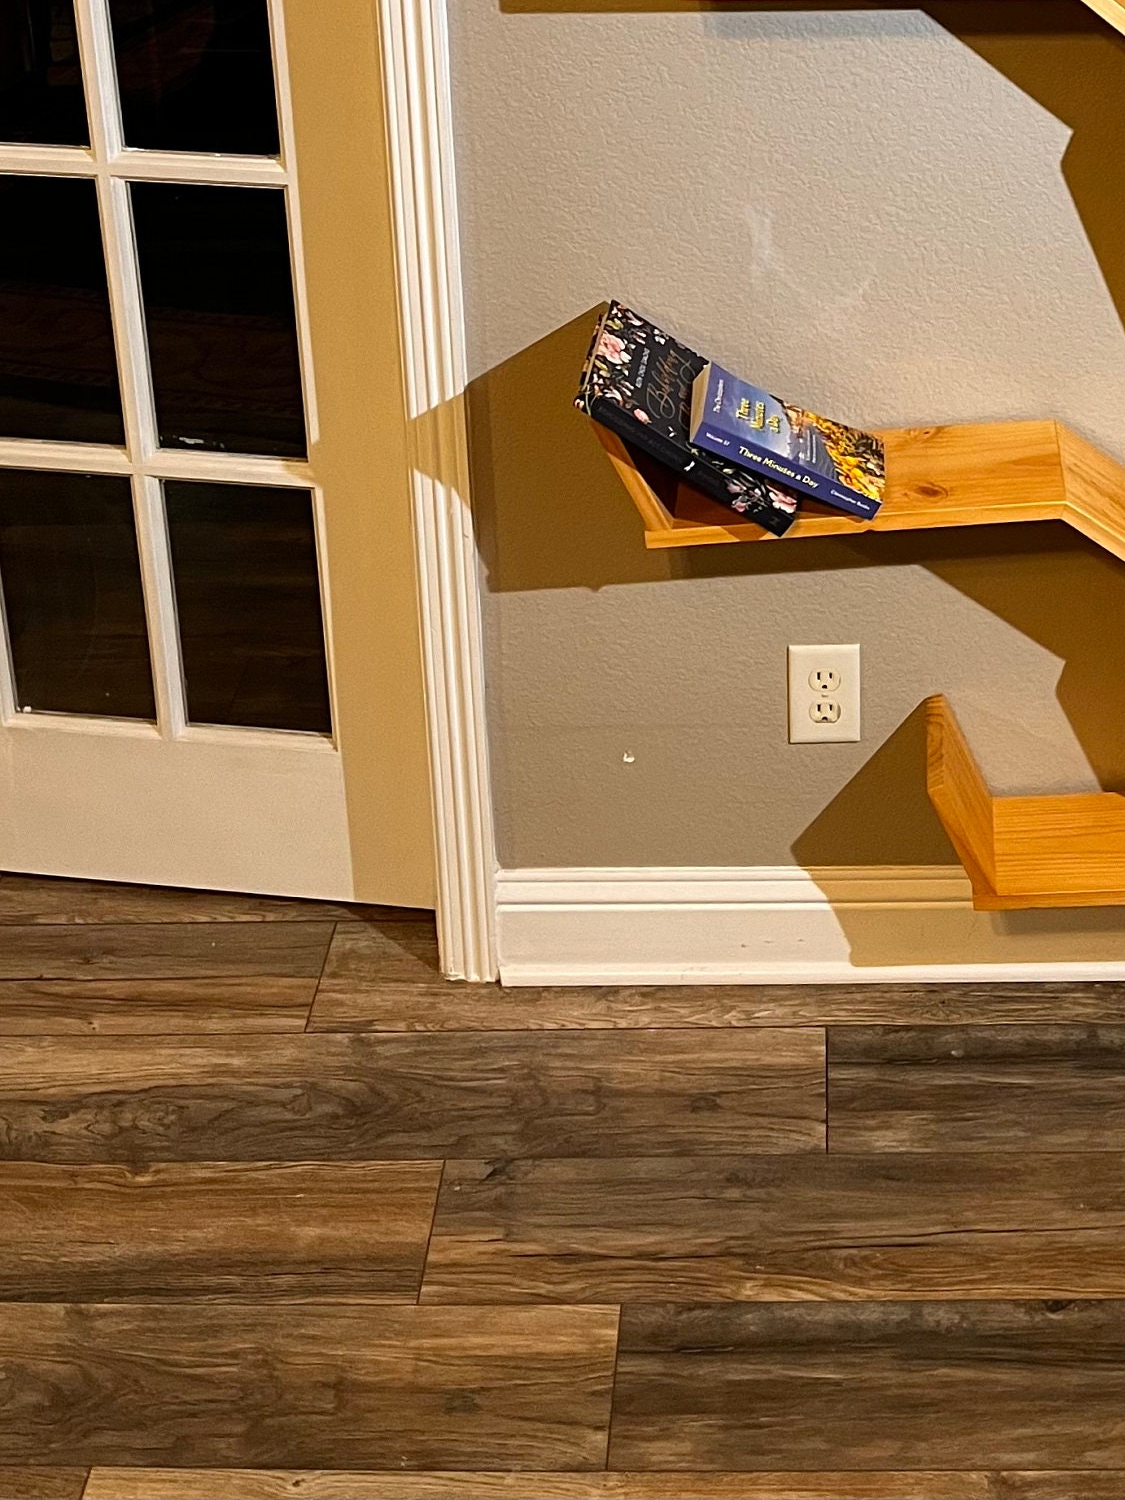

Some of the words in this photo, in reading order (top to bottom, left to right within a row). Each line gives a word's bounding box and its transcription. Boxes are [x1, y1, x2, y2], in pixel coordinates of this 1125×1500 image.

[739, 445, 762, 463] Three
[763, 457, 795, 478] Minutes
[801, 475, 819, 489] Day
